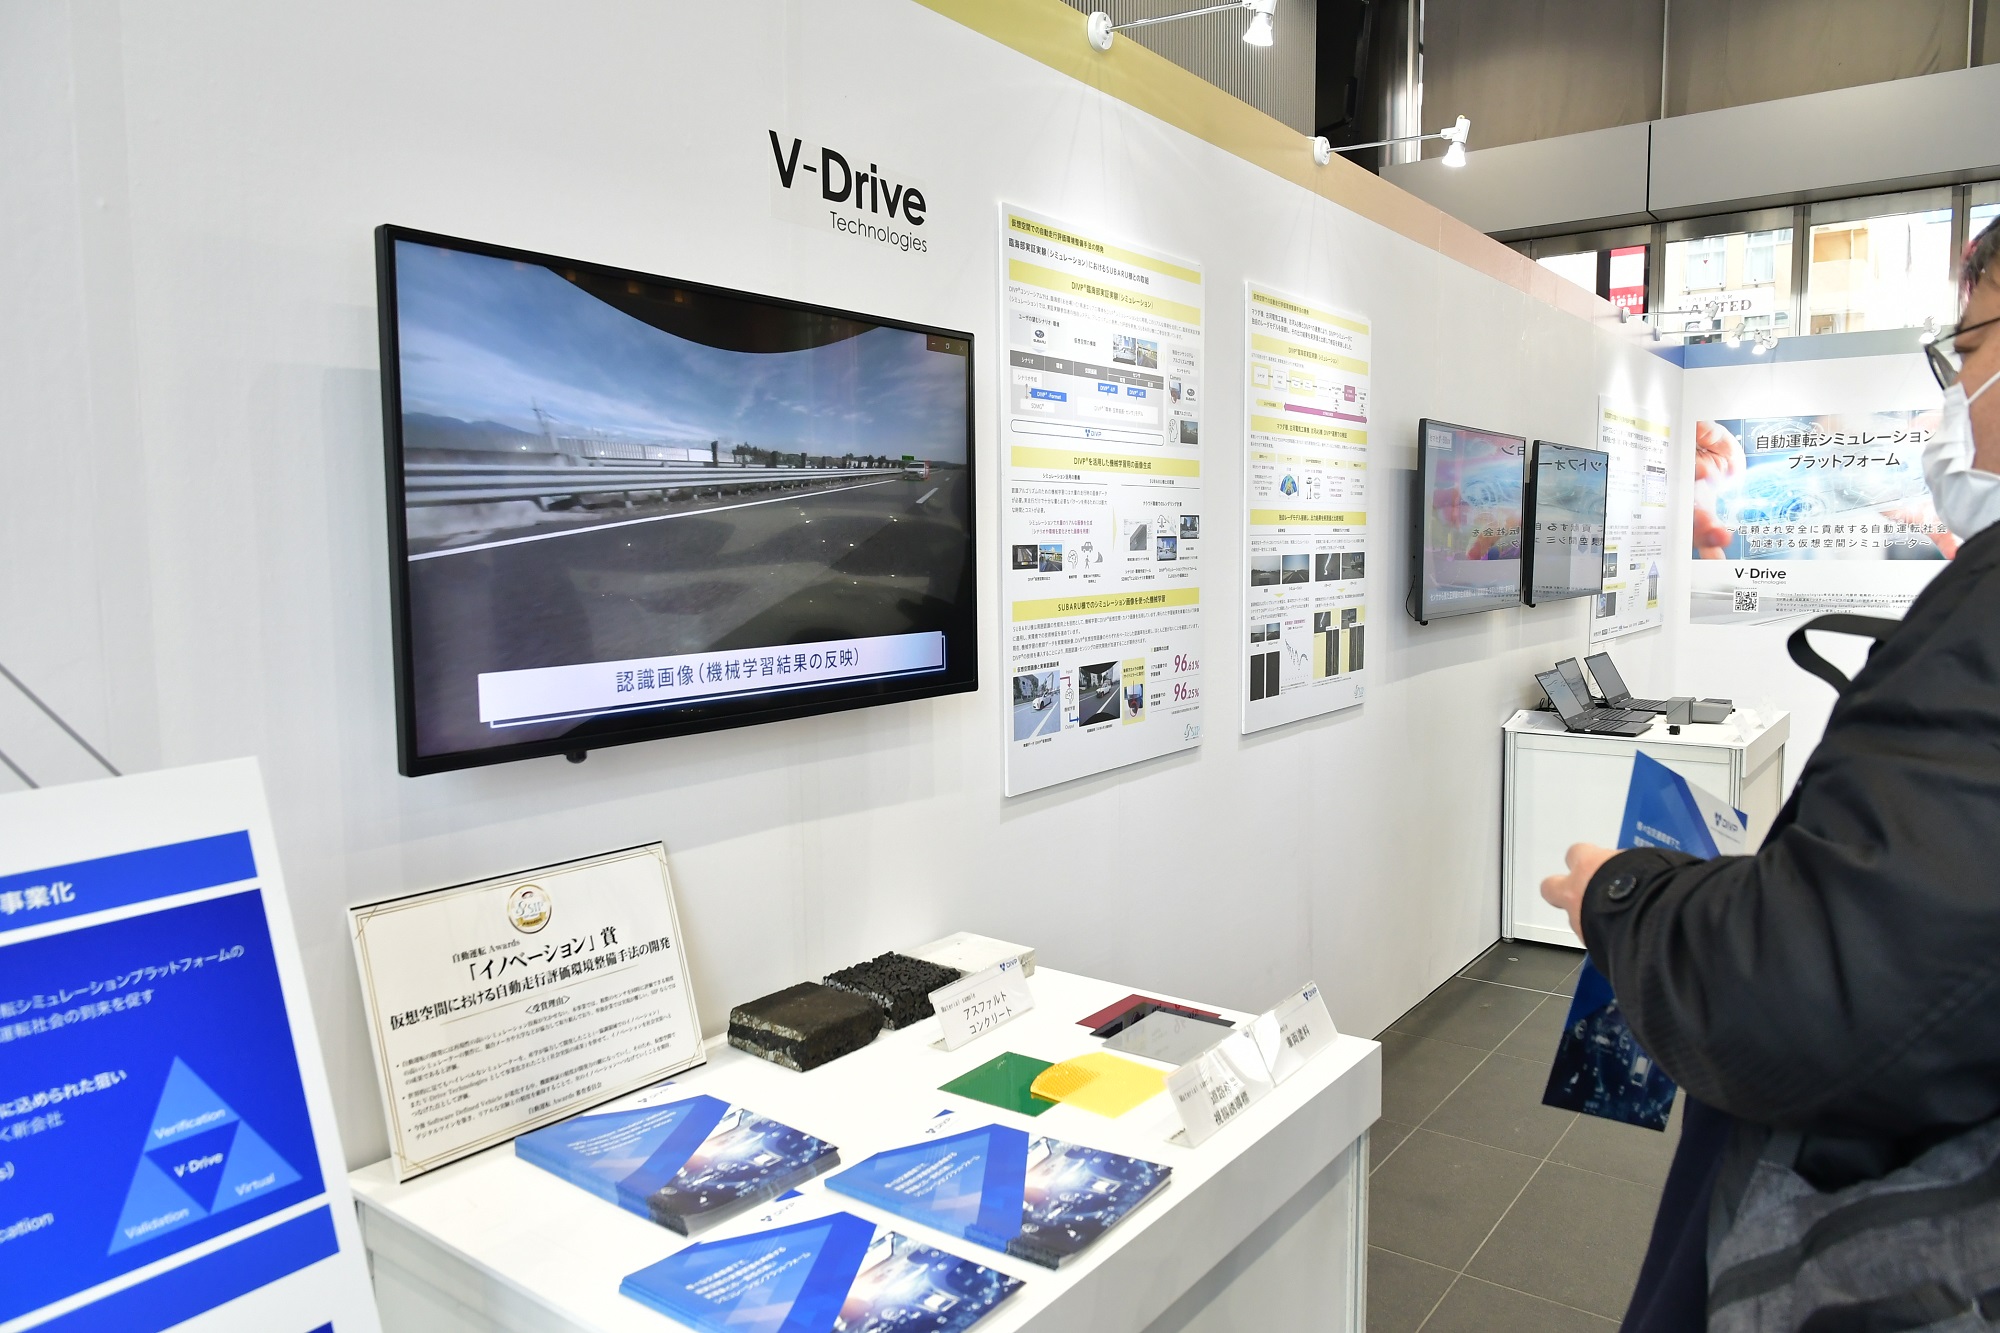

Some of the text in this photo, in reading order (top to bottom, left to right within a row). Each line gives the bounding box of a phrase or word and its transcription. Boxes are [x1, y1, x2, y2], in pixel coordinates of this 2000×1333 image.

[768, 129, 927, 226] V-Drive
[829, 210, 928, 253] Technologies
[1756, 429, 1936, 450] 自動運転シミュレーション
[1788, 452, 1901, 470] プラットフォーム
[1734, 568, 1787, 579] V-Drive
[616, 647, 859, 693] 認識画像(機械学習結果の反映)
[1174, 653, 1200, 674] 96.61%
[1174, 681, 1200, 702] 96.25%
[452, 938, 521, 964] 自動運転 Awards
[390, 937, 671, 1031] 仮想空間における自動走行評価環境整備手法の開発
[963, 991, 1007, 1020] アスファルト
[969, 1006, 1012, 1035] コンクリート
[154, 1108, 226, 1140] Verification
[234, 1172, 276, 1196] Virtual
[124, 1207, 190, 1240] Validation
